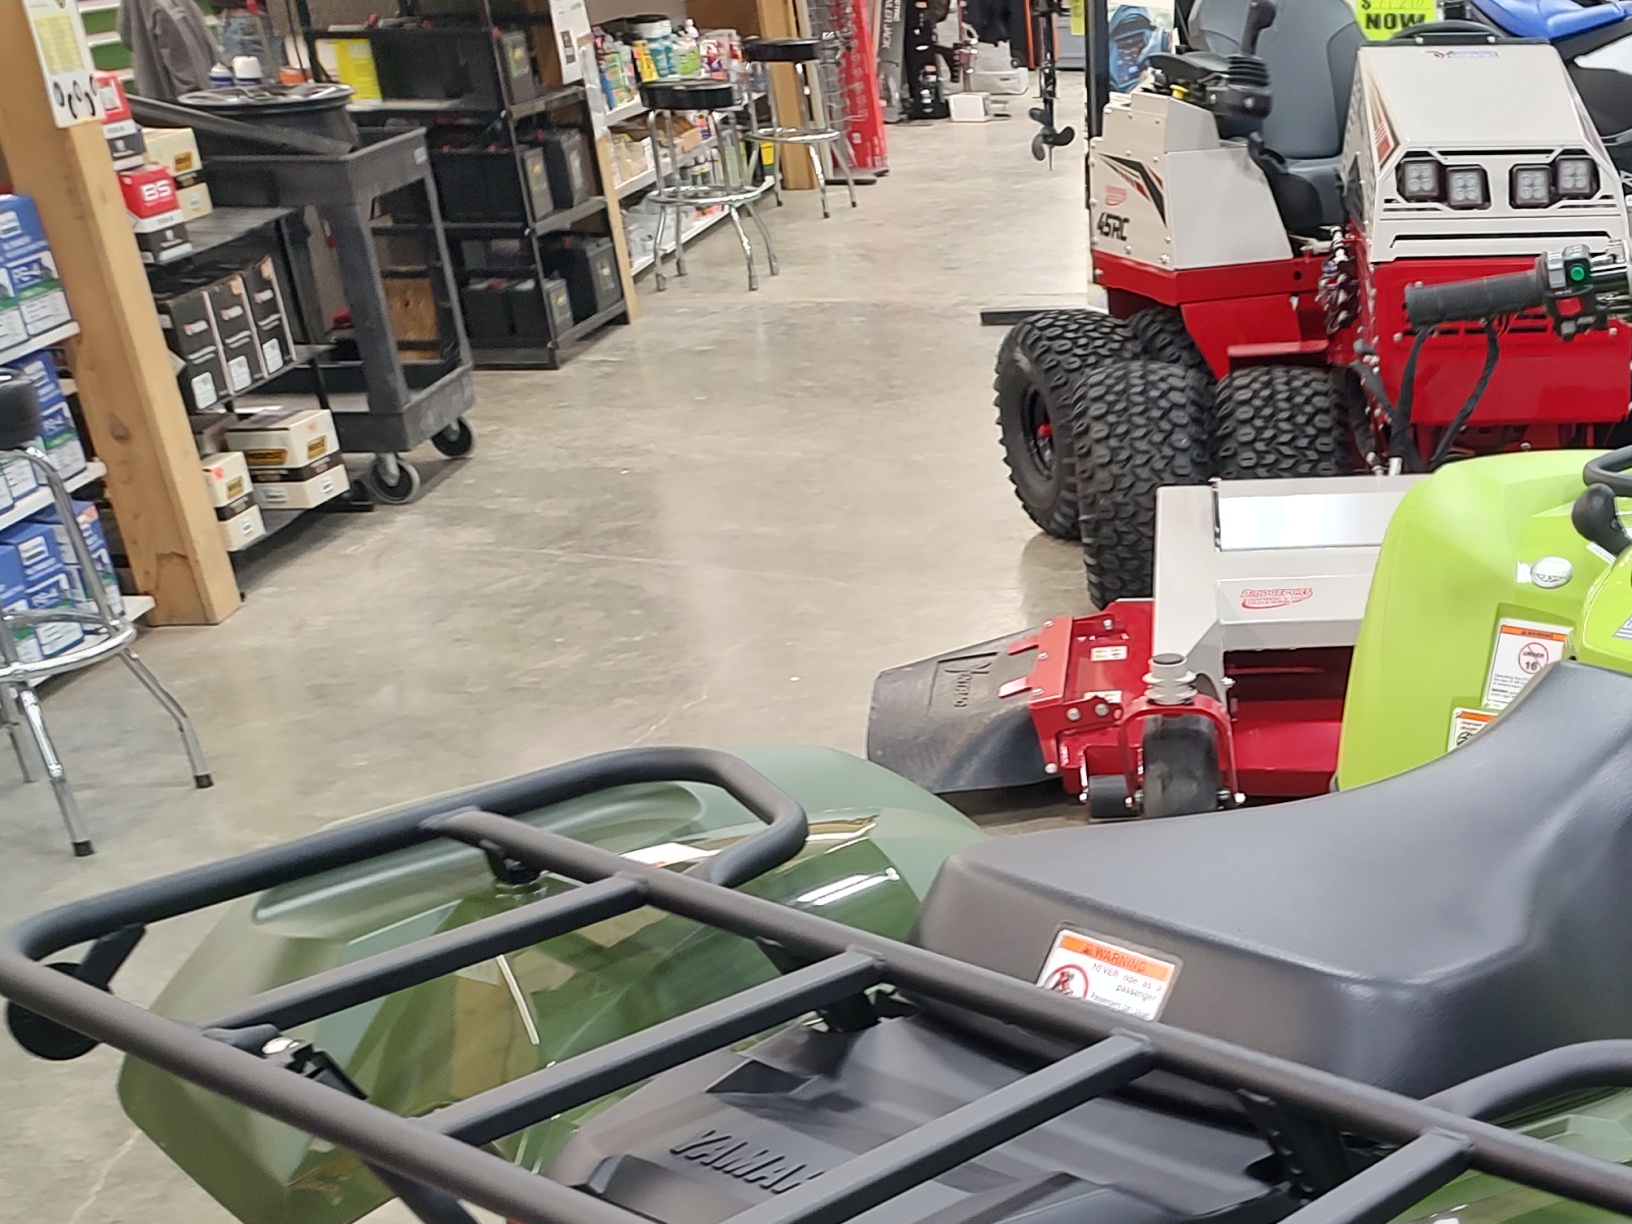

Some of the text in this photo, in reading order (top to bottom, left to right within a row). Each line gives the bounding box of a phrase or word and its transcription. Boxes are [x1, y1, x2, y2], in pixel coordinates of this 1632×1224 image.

[1365, 13, 1426, 30] NOW
[140, 179, 172, 202] BS
[1524, 661, 1538, 671] 16
[1094, 945, 1148, 973] WARNING
[1092, 963, 1119, 977] NEVER
[1115, 984, 1158, 1002] passenger
[669, 1129, 826, 1195] YAMA
